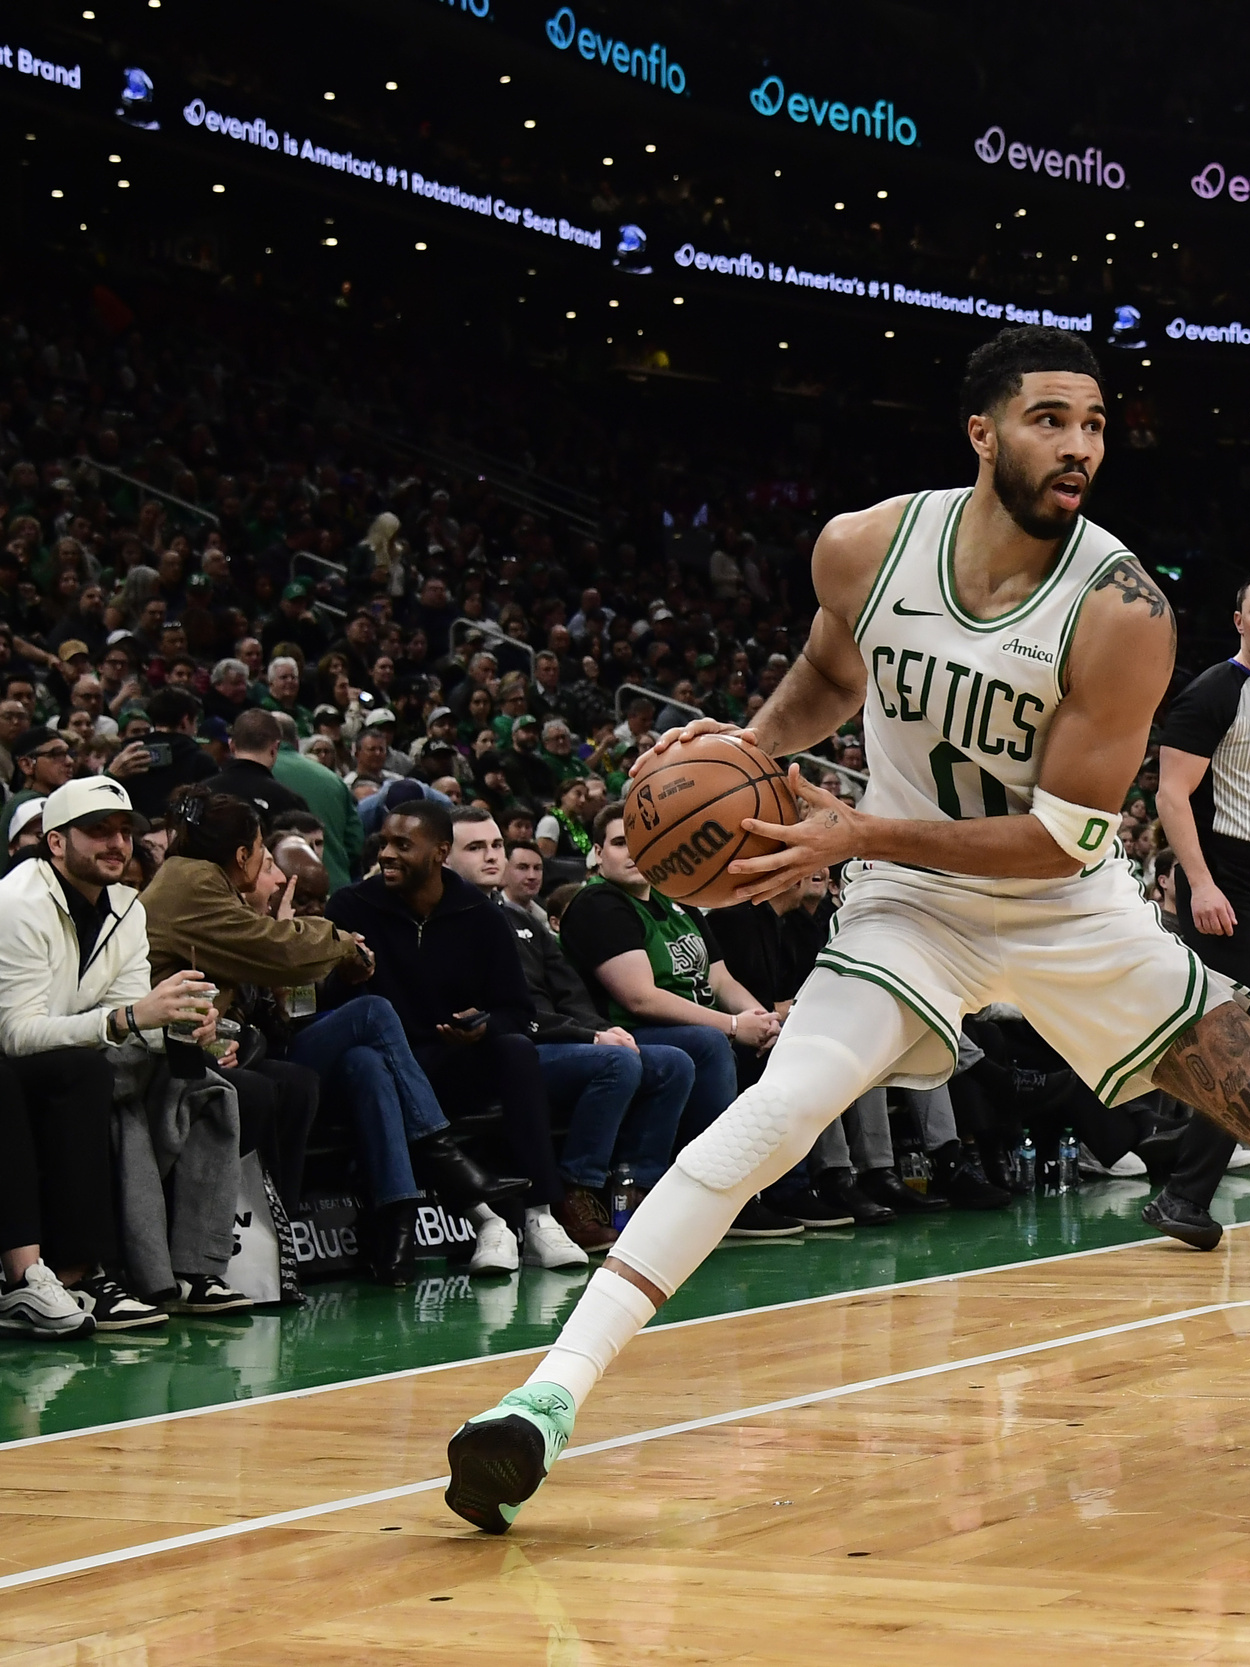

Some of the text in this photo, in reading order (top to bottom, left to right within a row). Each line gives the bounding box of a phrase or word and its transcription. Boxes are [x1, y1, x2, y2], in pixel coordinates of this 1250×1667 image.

[18, 48, 81, 89] Brand
[577, 27, 686, 95] evenflo
[787, 92, 917, 146] evenflo
[205, 110, 601, 250] evenflo is America's #1 Rotational Car Seat Brand
[1007, 142, 1126, 189] evenflo
[695, 252, 1092, 332] evenflo is America's #1 Rotational Car Seat Brand
[1003, 638, 1053, 664] Amica
[872, 646, 1044, 762] CELTICS
[642, 819, 734, 886] Wilson
